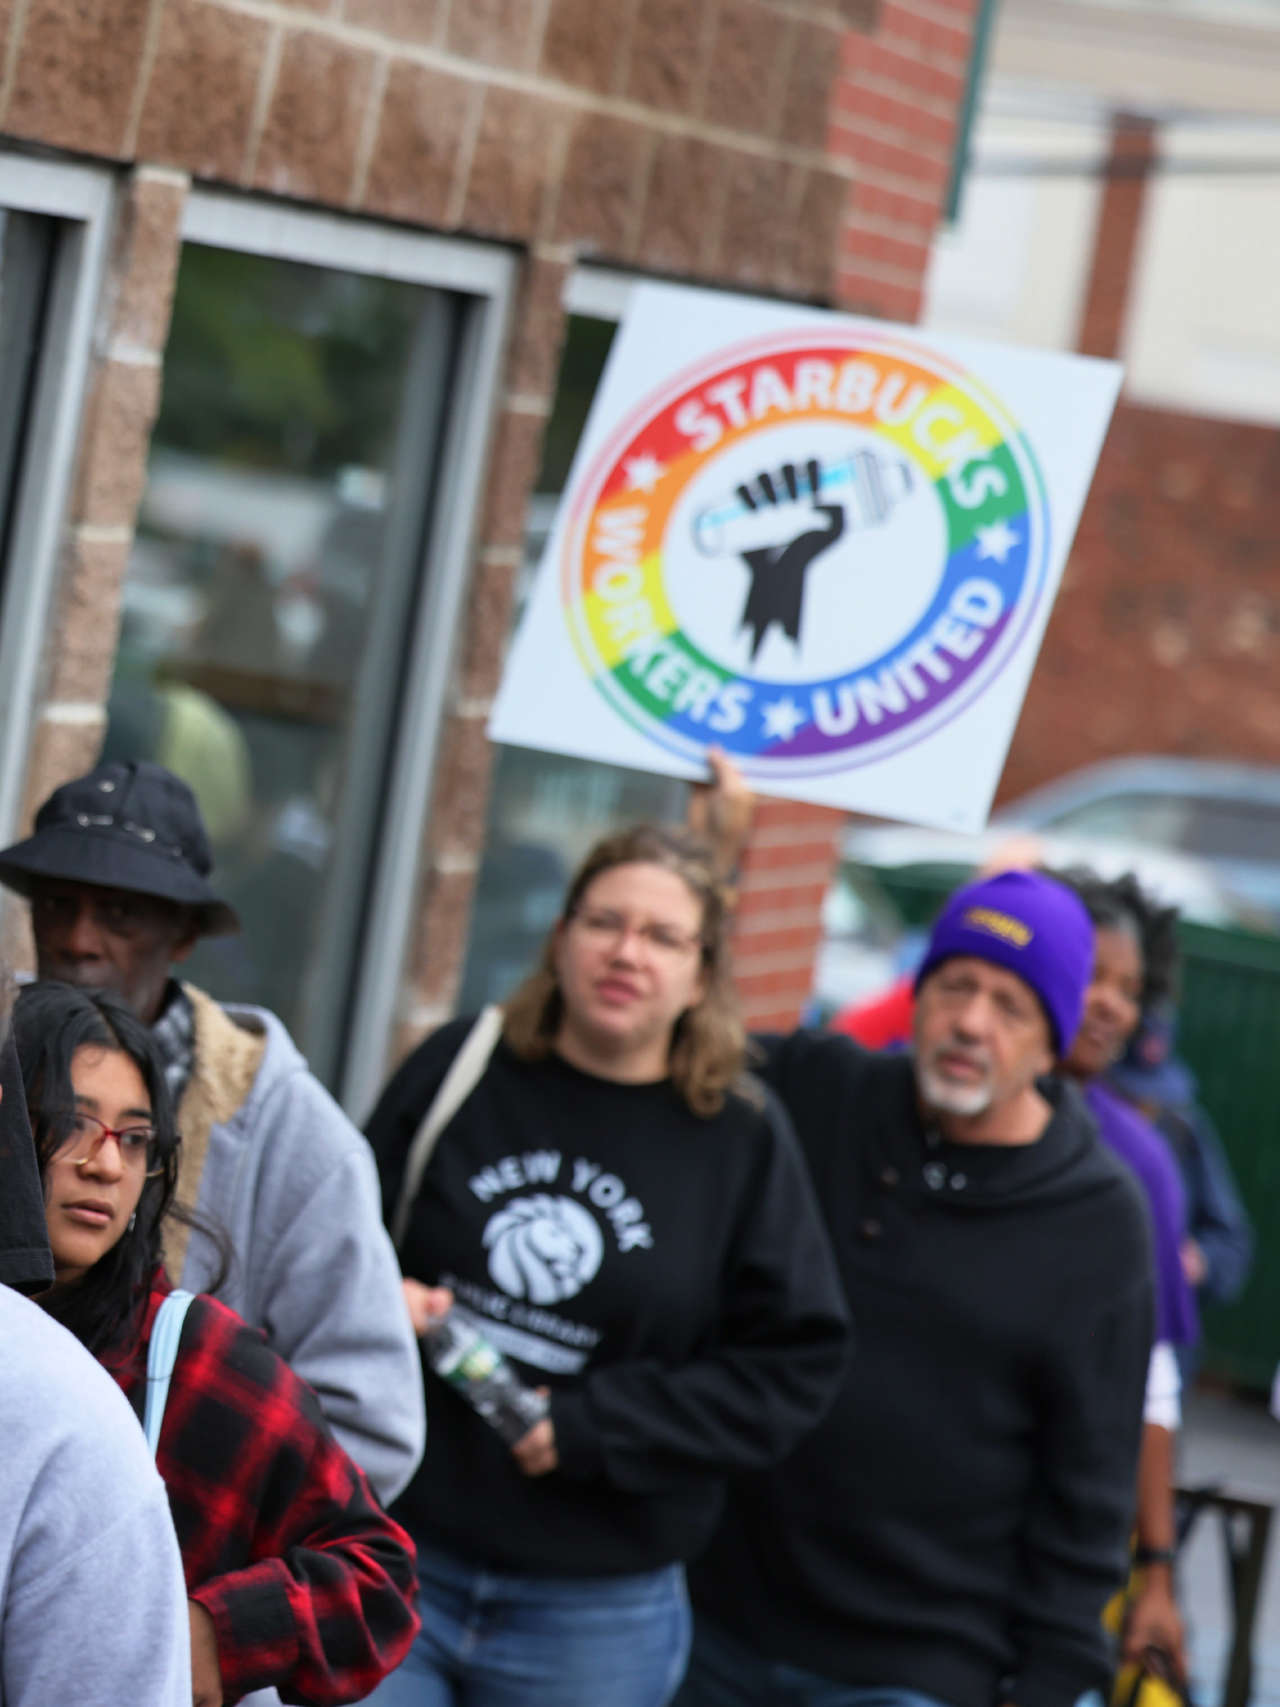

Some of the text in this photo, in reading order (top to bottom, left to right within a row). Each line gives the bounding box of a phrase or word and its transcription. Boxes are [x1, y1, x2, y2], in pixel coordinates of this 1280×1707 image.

[674, 360, 1008, 510] STARBUCKS
[593, 505, 755, 733] WORKERS
[812, 578, 1004, 737] UNITED
[469, 1149, 655, 1252] NEW YORK
